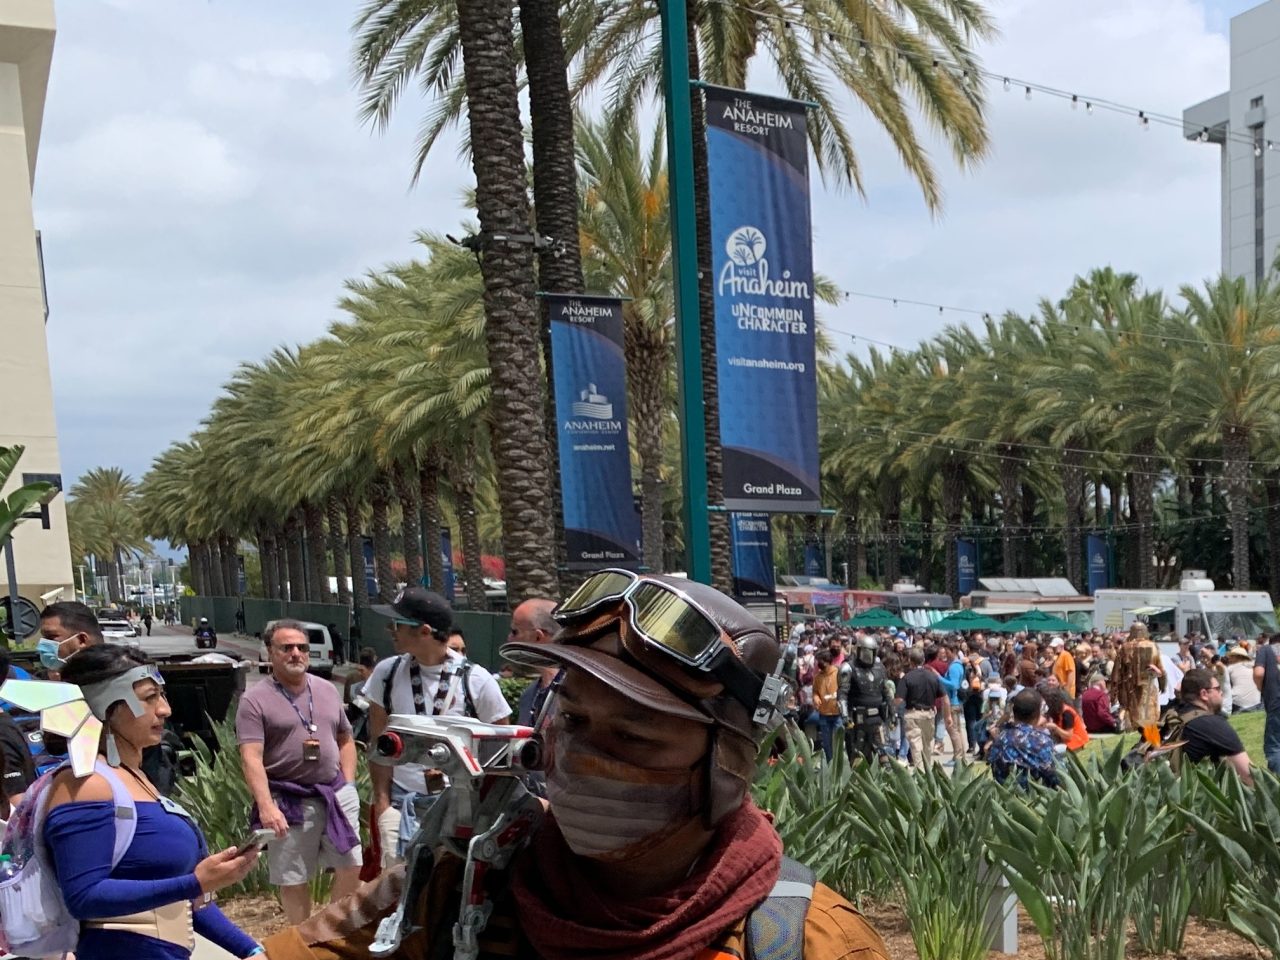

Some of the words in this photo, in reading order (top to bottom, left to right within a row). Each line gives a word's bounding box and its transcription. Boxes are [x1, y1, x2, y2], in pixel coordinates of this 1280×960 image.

[734, 97, 752, 109] THE
[722, 105, 793, 129] ANAHEIM
[734, 121, 769, 136] RESORT
[718, 257, 811, 299] Anaheim
[738, 267, 757, 276] visit
[561, 306, 613, 318] ANAHEIM
[737, 316, 807, 335] CHARACTER
[727, 356, 805, 373] visitanaheim.org
[564, 420, 622, 432] ANAHEIM
[743, 482, 774, 494] Grand
[776, 483, 802, 495] Plaza
